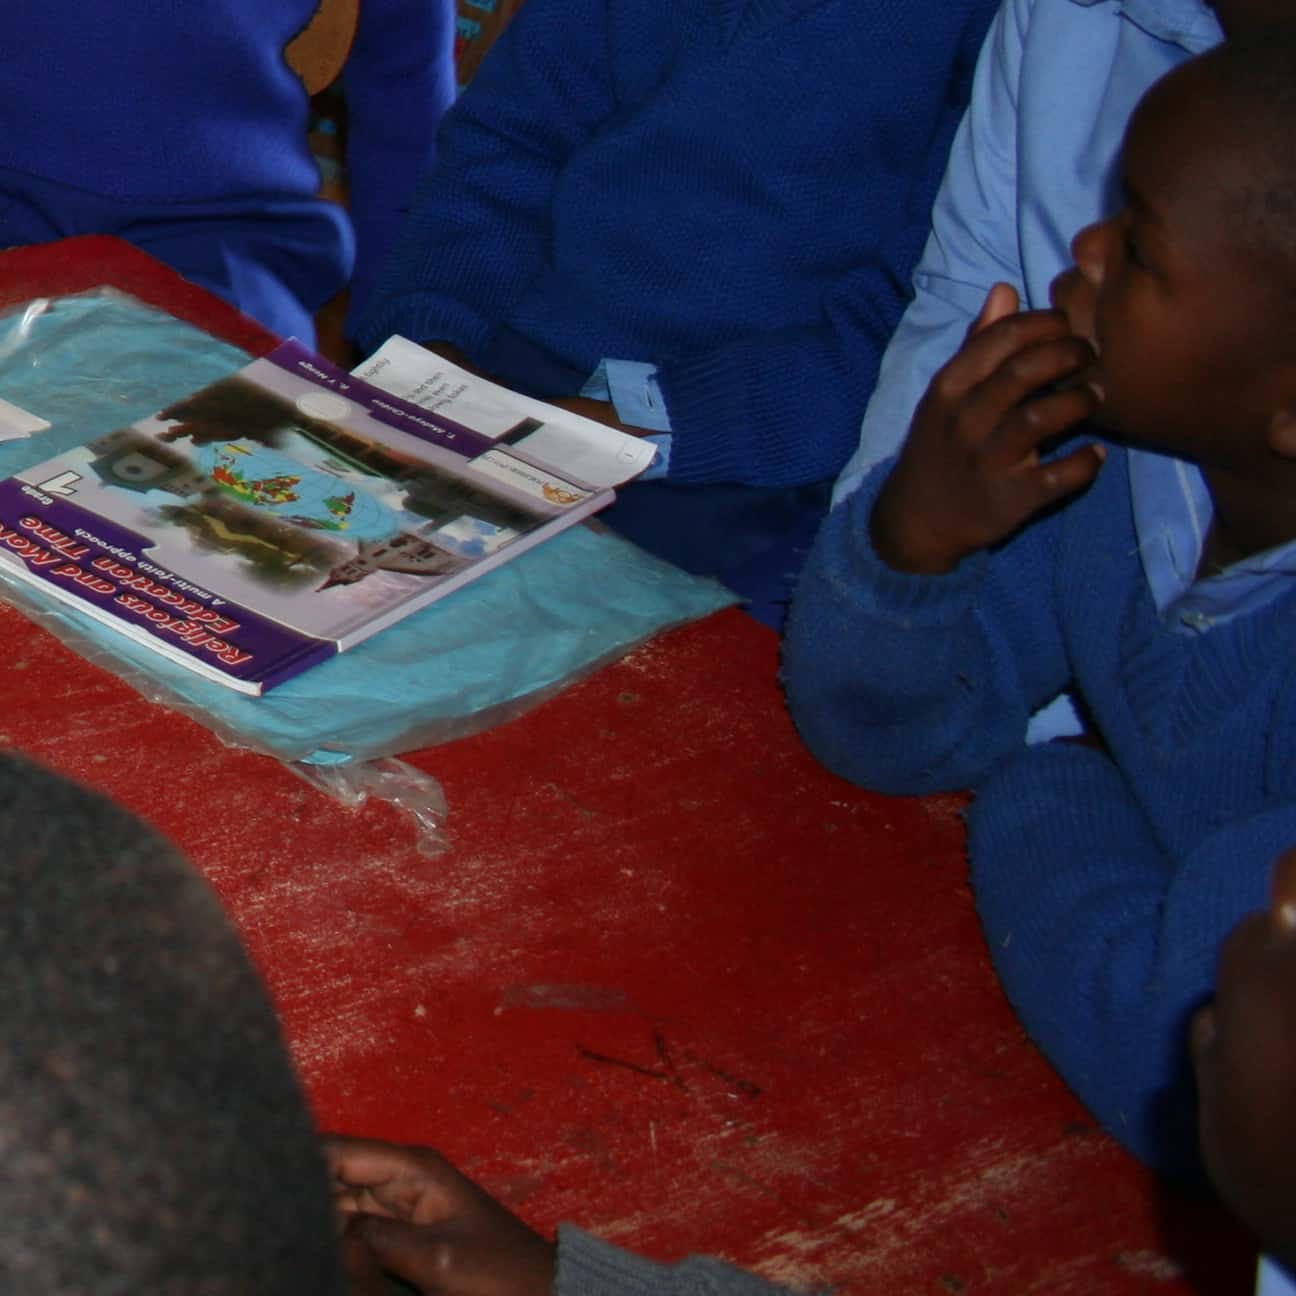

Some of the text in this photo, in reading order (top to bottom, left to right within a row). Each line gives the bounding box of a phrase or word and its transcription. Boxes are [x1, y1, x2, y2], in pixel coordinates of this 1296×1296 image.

[22, 484, 53, 504] Grade
[74, 527, 137, 562] approach
[19, 516, 240, 633] Education Time
[53, 563, 117, 594] and
[137, 561, 210, 599] multi-faith
[114, 594, 253, 665] Religious
